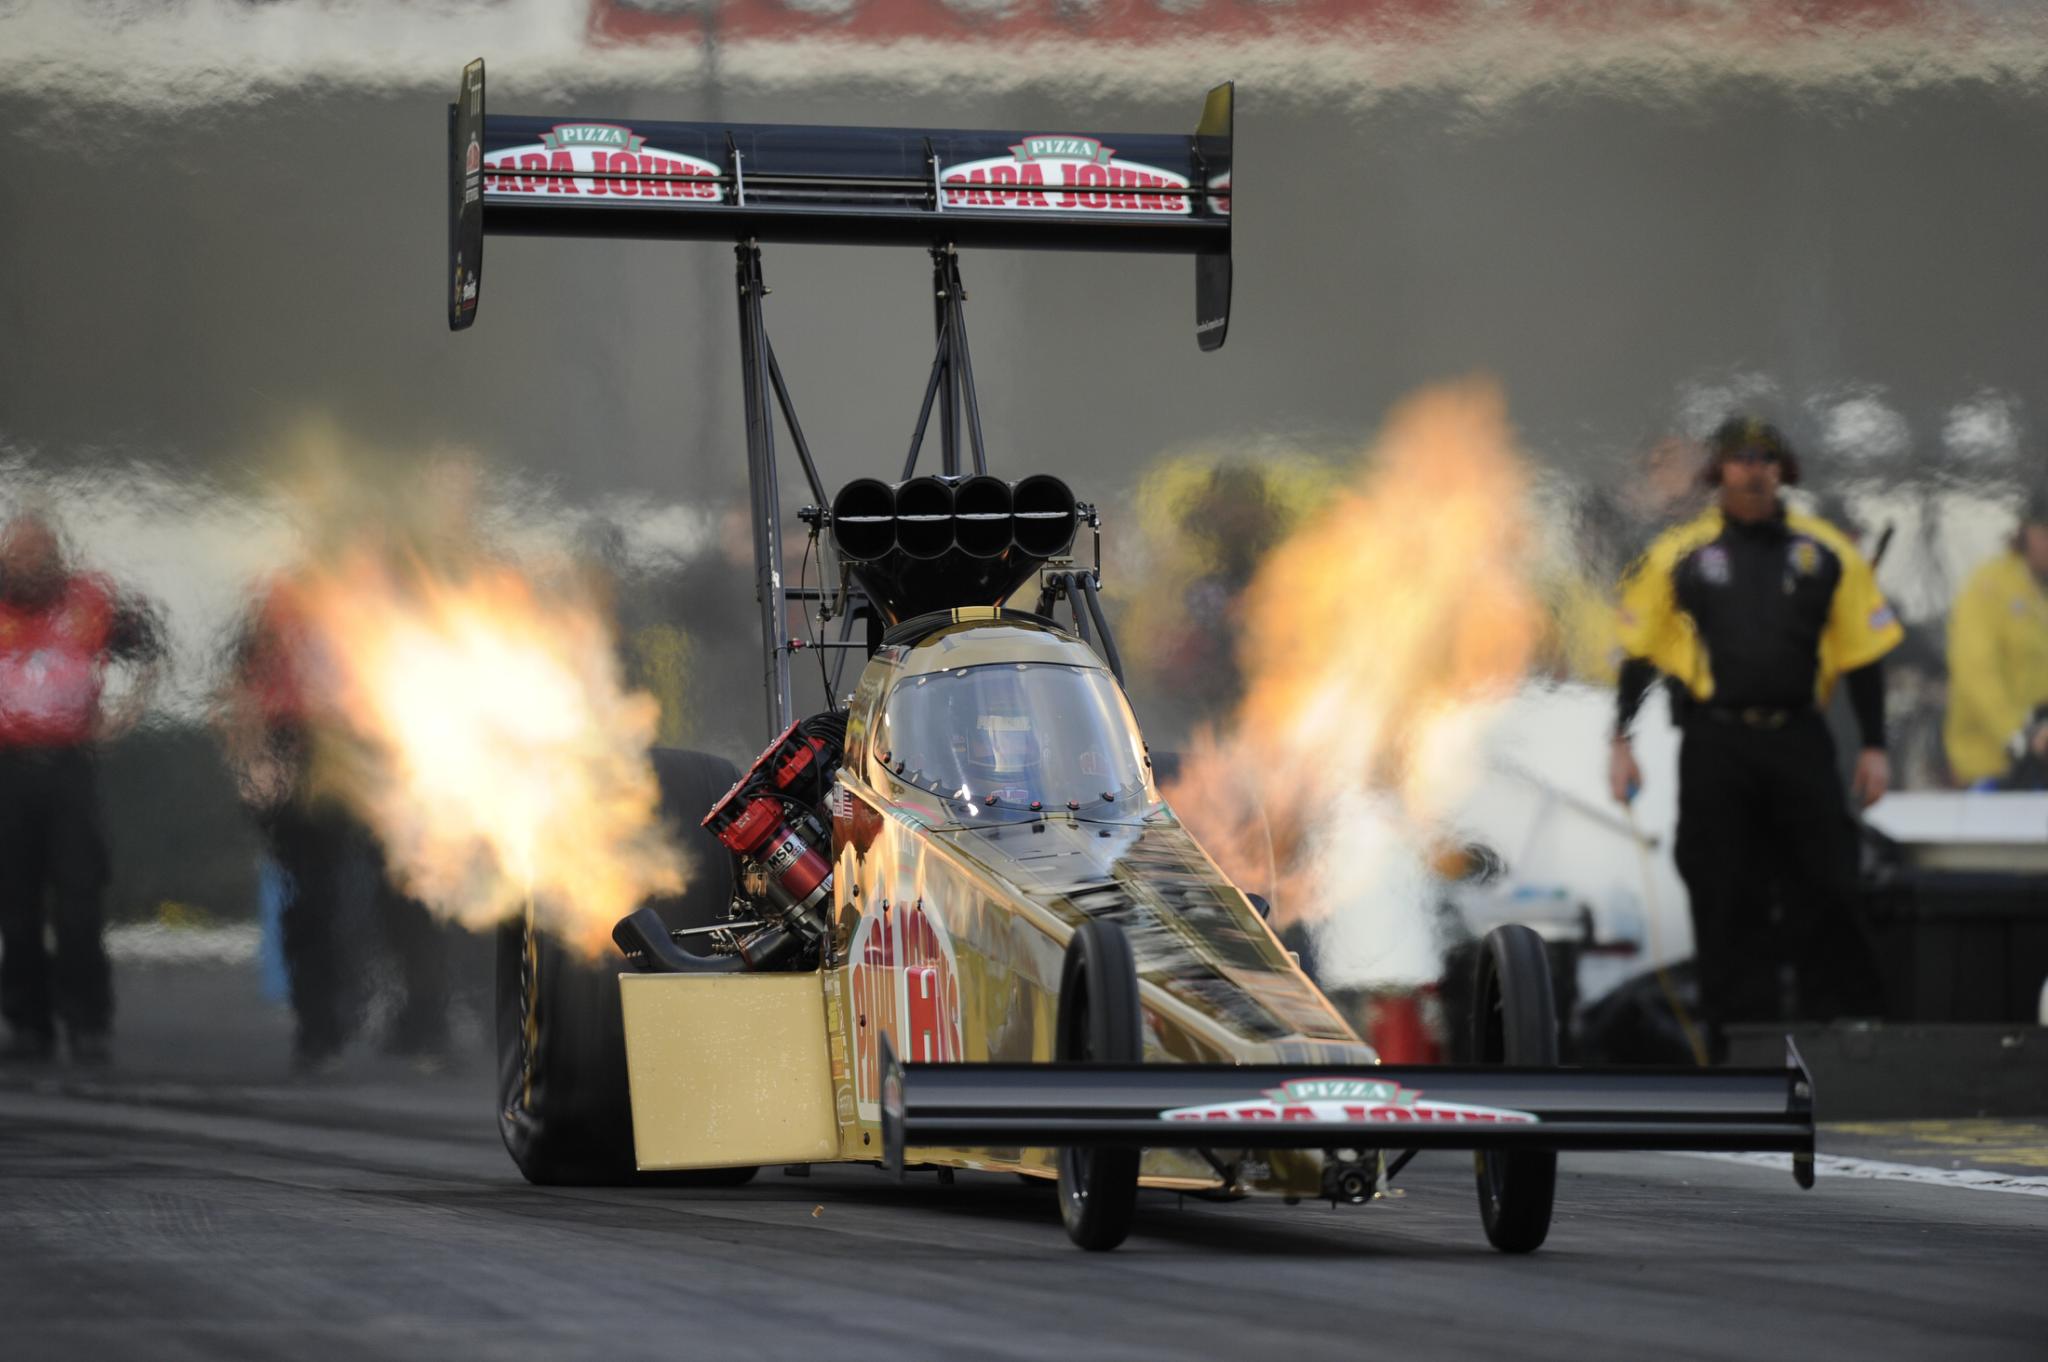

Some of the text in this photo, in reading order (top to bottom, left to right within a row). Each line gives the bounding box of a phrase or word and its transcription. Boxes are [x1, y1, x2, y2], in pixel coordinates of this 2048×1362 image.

[562, 127, 624, 145] PIZZA
[1031, 139, 1093, 156] PIZZA
[946, 164, 1050, 207] PAPA
[767, 841, 794, 870] MSD
[1295, 1081, 1388, 1099] PIZZA
